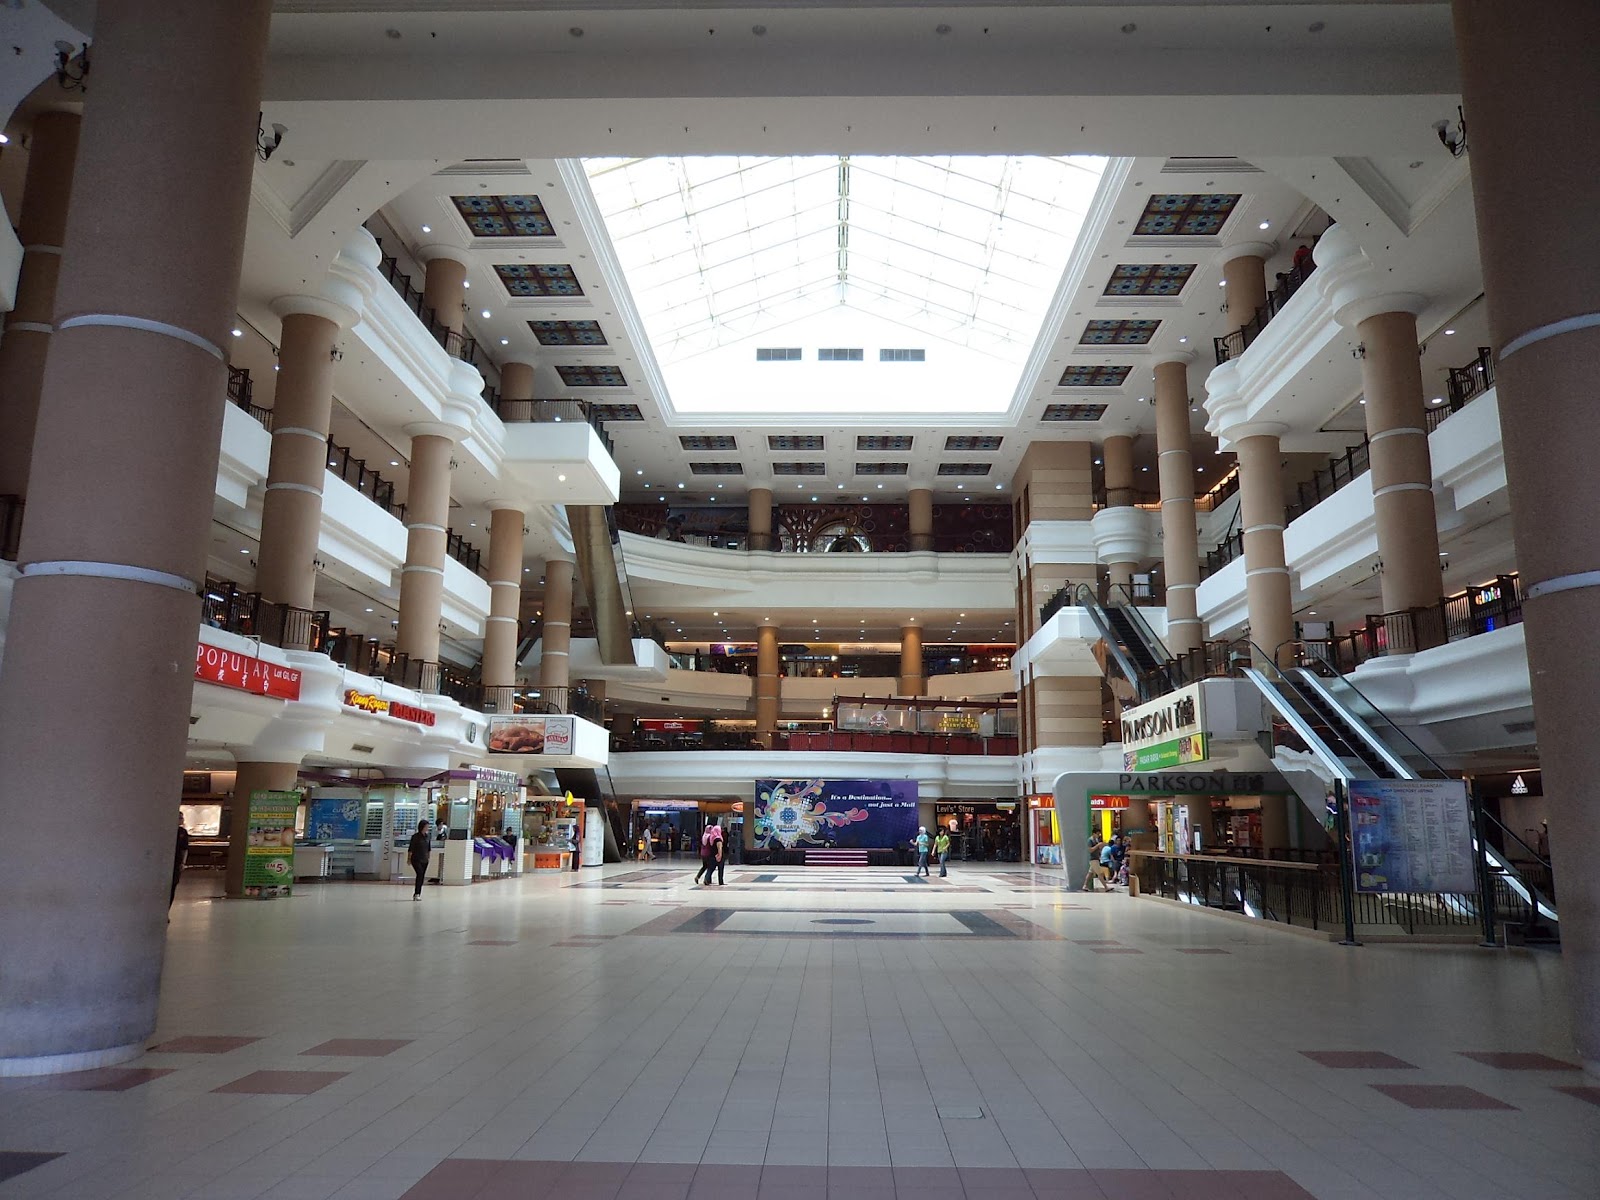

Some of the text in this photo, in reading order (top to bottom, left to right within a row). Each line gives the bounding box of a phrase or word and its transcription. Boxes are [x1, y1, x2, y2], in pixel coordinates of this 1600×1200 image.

[195, 645, 270, 680] POPULAR
[392, 701, 436, 727] ROASTERS
[1122, 706, 1173, 744] PARKSON
[1119, 774, 1224, 791] PARKSON
[958, 804, 975, 813] Store
